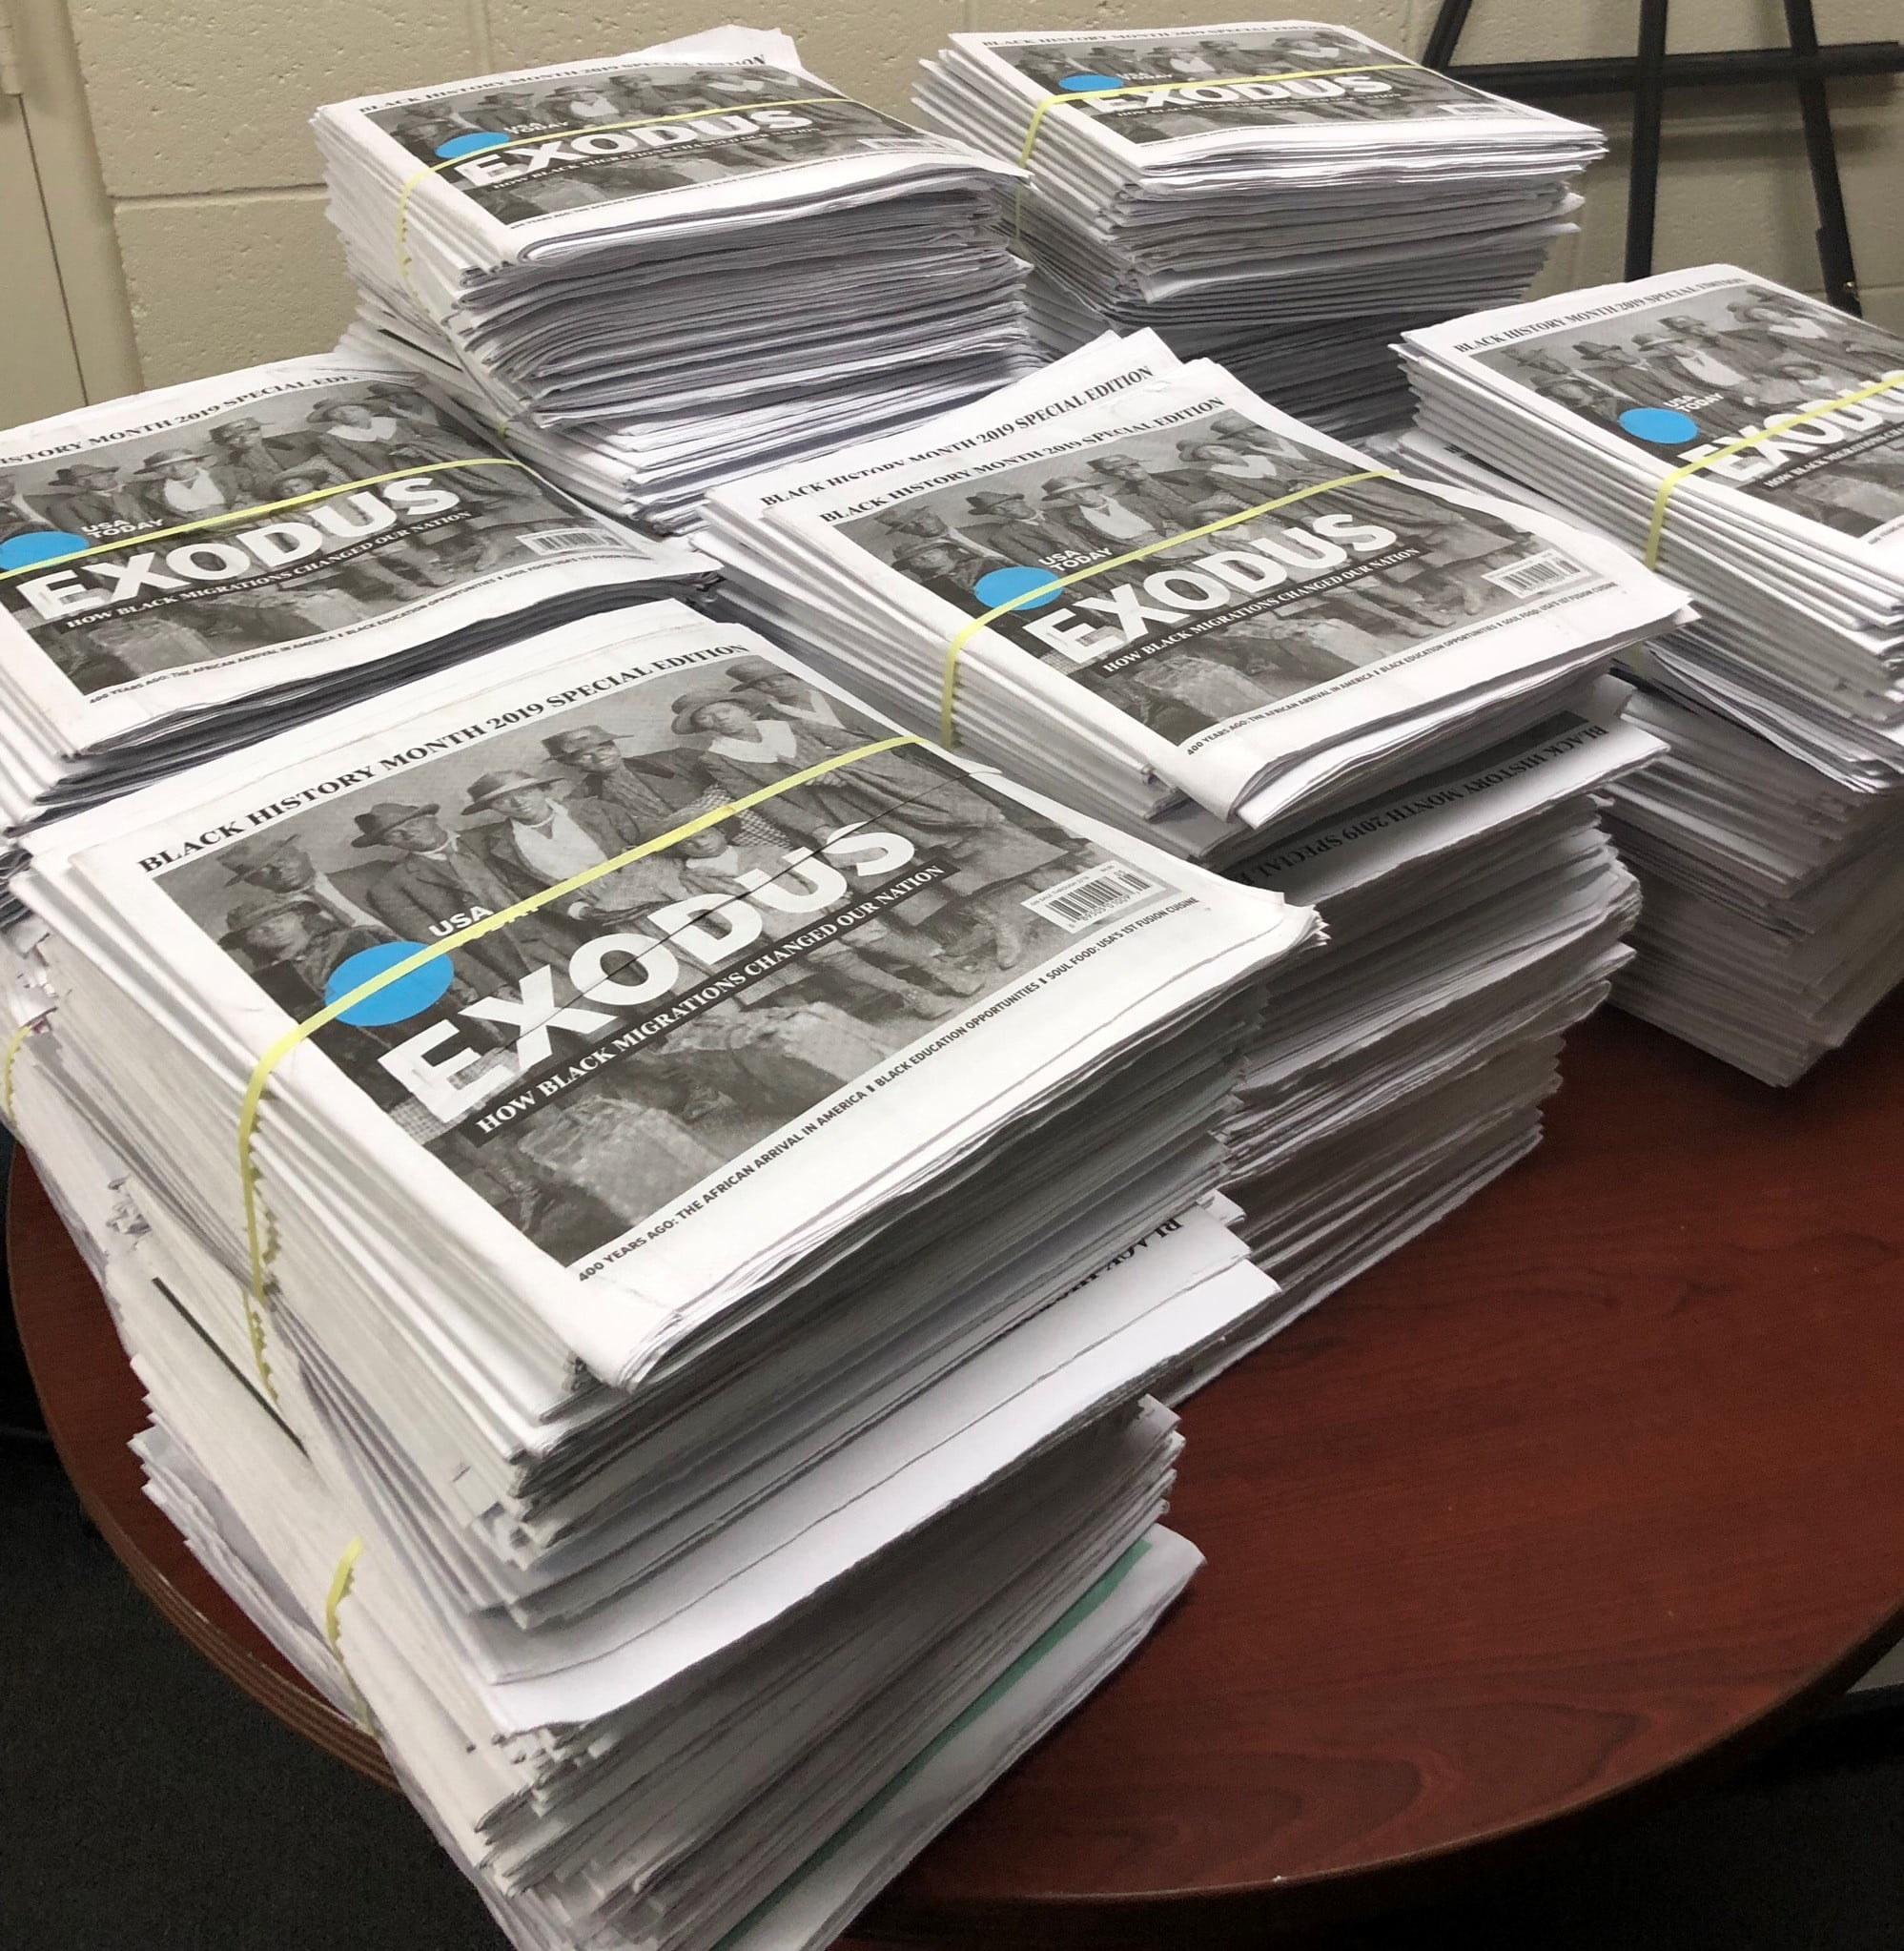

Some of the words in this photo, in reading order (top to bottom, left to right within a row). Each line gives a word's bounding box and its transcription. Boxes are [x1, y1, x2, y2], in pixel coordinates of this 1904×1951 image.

[358, 95, 421, 113] BLACK
[426, 81, 504, 99] HISTORY
[1081, 75, 1393, 113] EXODUS
[454, 110, 813, 188] EXODUS
[1453, 331, 1504, 353] BLACK
[1503, 318, 1566, 341] HISTORY
[1564, 304, 1623, 326] MONTH
[1617, 297, 1648, 312] 2019
[1646, 284, 1702, 305] SPECIAL
[0, 442, 83, 465] ISTORY
[89, 420, 174, 445] MONTH
[174, 405, 221, 423] 2019
[222, 380, 311, 407] SPECIAL
[760, 482, 826, 506] BLACK
[975, 424, 1015, 445] 2019
[1013, 396, 1088, 430] SPECIAL
[1089, 365, 1155, 402] EDITION
[1664, 394, 1697, 410] USA
[1676, 392, 1725, 413] TODAY
[1677, 369, 1904, 482] EXODU
[819, 496, 890, 523] BLACK
[888, 468, 972, 500] HISTORY
[972, 450, 1045, 476] MONTH
[1042, 440, 1083, 456] 2019
[1081, 422, 1157, 446] SPECIAL
[1156, 396, 1226, 427] EDITION
[15, 478, 461, 621] EXODUS
[81, 518, 132, 533] USA
[87, 518, 165, 540] TODAY
[1037, 549, 1081, 566] USA
[1048, 547, 1114, 571] TODAY
[66, 610, 113, 628] HOW
[115, 595, 179, 615] BLACK
[178, 570, 293, 601] MIGRATIONS
[293, 542, 374, 575] CHANGED
[374, 528, 411, 545] OUR
[409, 509, 473, 532] NATION
[1022, 513, 1398, 665] EXODUS
[1102, 650, 1142, 674] HOW
[1142, 629, 1194, 656] BLACK
[1192, 597, 1280, 635] MIGRATIONS
[1278, 575, 1344, 603] CHANGED
[1341, 565, 1374, 580] OUR
[1369, 546, 1422, 570] NATION
[1185, 740, 1205, 756] 400
[1201, 725, 1232, 744] YEARS
[1248, 711, 1268, 725] THE
[1264, 701, 1300, 718] AFRICAN
[1298, 688, 1332, 707] ARRIVAL
[1329, 684, 1341, 694] IN
[1338, 671, 1375, 691] AMERICA
[1379, 658, 1406, 673] BLACK
[1403, 642, 1445, 665] EDUCATION
[1442, 623, 1498, 647] OPPORTUNITIES
[1501, 614, 1521, 628] SOUL
[137, 820, 245, 873] BLACK
[244, 766, 377, 827] HISTORY
[378, 724, 487, 771] MONTH
[485, 703, 544, 730] 2019
[545, 667, 654, 708] SPECIAL
[650, 644, 751, 671] EDITION
[1465, 753, 1548, 794] HISTORY
[1545, 724, 1610, 758] BLACK
[1341, 815, 1389, 842] 2019
[1385, 787, 1465, 824] MONTH
[1258, 832, 1344, 878] SPECIAL
[428, 905, 495, 937] USA
[377, 820, 915, 1124] EXODUS
[476, 1090, 537, 1134] HOW
[536, 1047, 617, 1095] BLACK
[613, 972, 747, 1053] MIGRATIONS
[743, 923, 840, 977] CHANGED
[835, 900, 880, 928] OUR
[873, 865, 945, 906] NATION
[578, 1261, 604, 1283] 400
[602, 1237, 647, 1264] YEARS
[646, 1218, 680, 1241] AGO:
[674, 1199, 705, 1221] THE
[701, 1163, 756, 1204] AFRICAN
[752, 1132, 805, 1170] ARRIVAL
[801, 1122, 819, 1136] IN
[816, 1090, 869, 1127] AMERICA
[873, 1059, 912, 1088] BLACK
[908, 1025, 969, 1065] EDUCATION
[964, 981, 1041, 1030] OPPORTUNITIES
[1045, 961, 1074, 980] SOUL
[1070, 945, 1100, 965] FOOD:
[1095, 930, 1125, 950] USA'S
[1120, 922, 1139, 935] 1ST
[1135, 909, 1170, 929] FUSION
[1165, 896, 1200, 914] CUISINE
